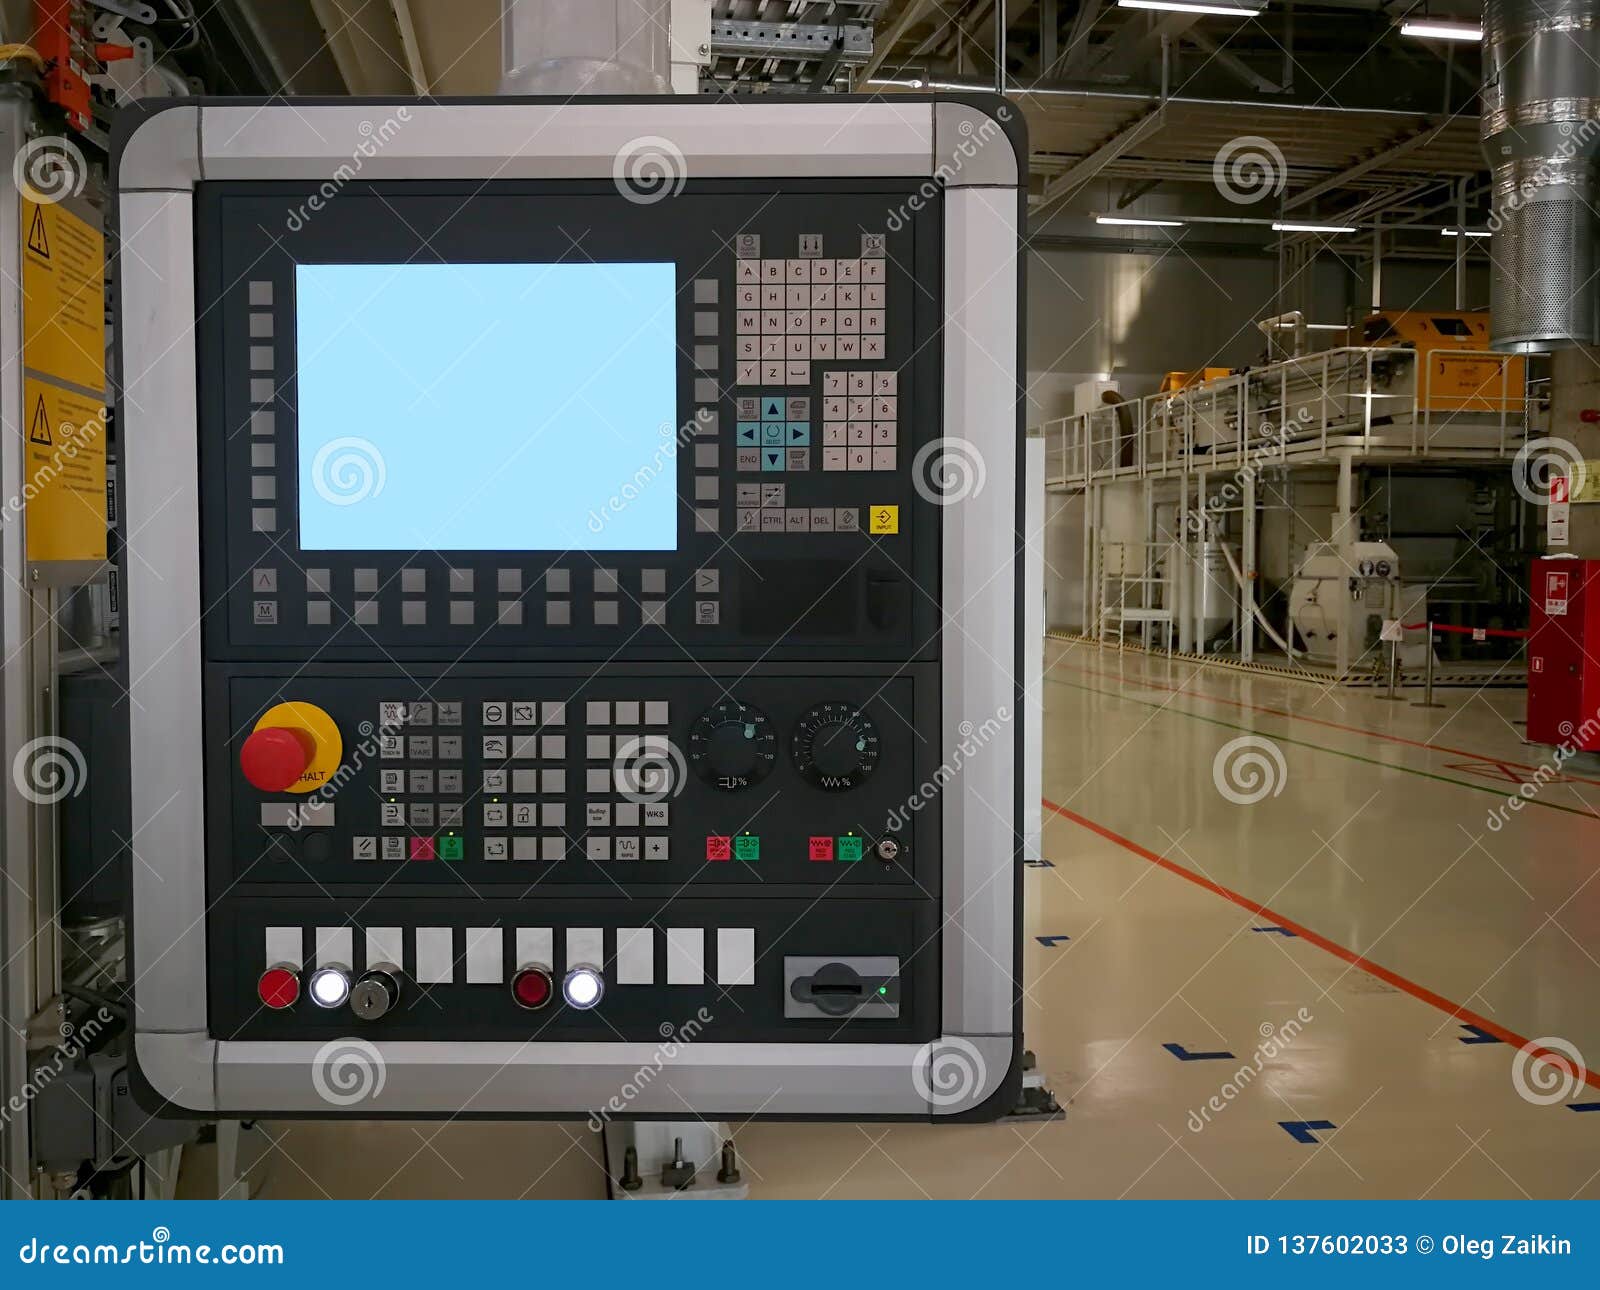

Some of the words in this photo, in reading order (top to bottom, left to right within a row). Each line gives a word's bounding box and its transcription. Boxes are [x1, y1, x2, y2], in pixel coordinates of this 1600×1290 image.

[744, 267, 753, 276] A
[770, 267, 777, 277] B
[794, 266, 802, 276] C
[819, 266, 828, 276] D
[845, 266, 852, 276] E
[870, 266, 877, 276] F
[744, 292, 753, 302] G
[769, 292, 777, 301] H
[796, 292, 800, 302] I
[820, 292, 827, 302] J
[844, 292, 852, 301] K
[870, 292, 877, 301] L
[743, 317, 753, 327] M
[769, 318, 777, 327] N
[794, 317, 803, 327] O
[820, 317, 827, 327] P
[844, 317, 853, 327] Q
[870, 317, 877, 326] R
[744, 343, 752, 353] S
[769, 343, 777, 352] T
[794, 343, 802, 352] U
[819, 343, 827, 352] V
[843, 343, 854, 352] W
[869, 343, 877, 352] X
[744, 368, 753, 377] Y
[769, 368, 777, 378] Z
[832, 379, 839, 388] 7
[857, 378, 864, 389] 8
[882, 379, 889, 388] 9
[831, 404, 838, 413] 4
[857, 404, 864, 414] 5
[881, 404, 889, 413] 6
[832, 429, 837, 439] 1
[857, 429, 863, 439] 2
[881, 429, 888, 439] 3
[856, 454, 863, 464] 0
[763, 516, 783, 525] CTRL
[790, 516, 804, 525] ALT
[814, 516, 829, 525] DEL
[260, 605, 271, 615] M
[299, 771, 327, 782] HALT
